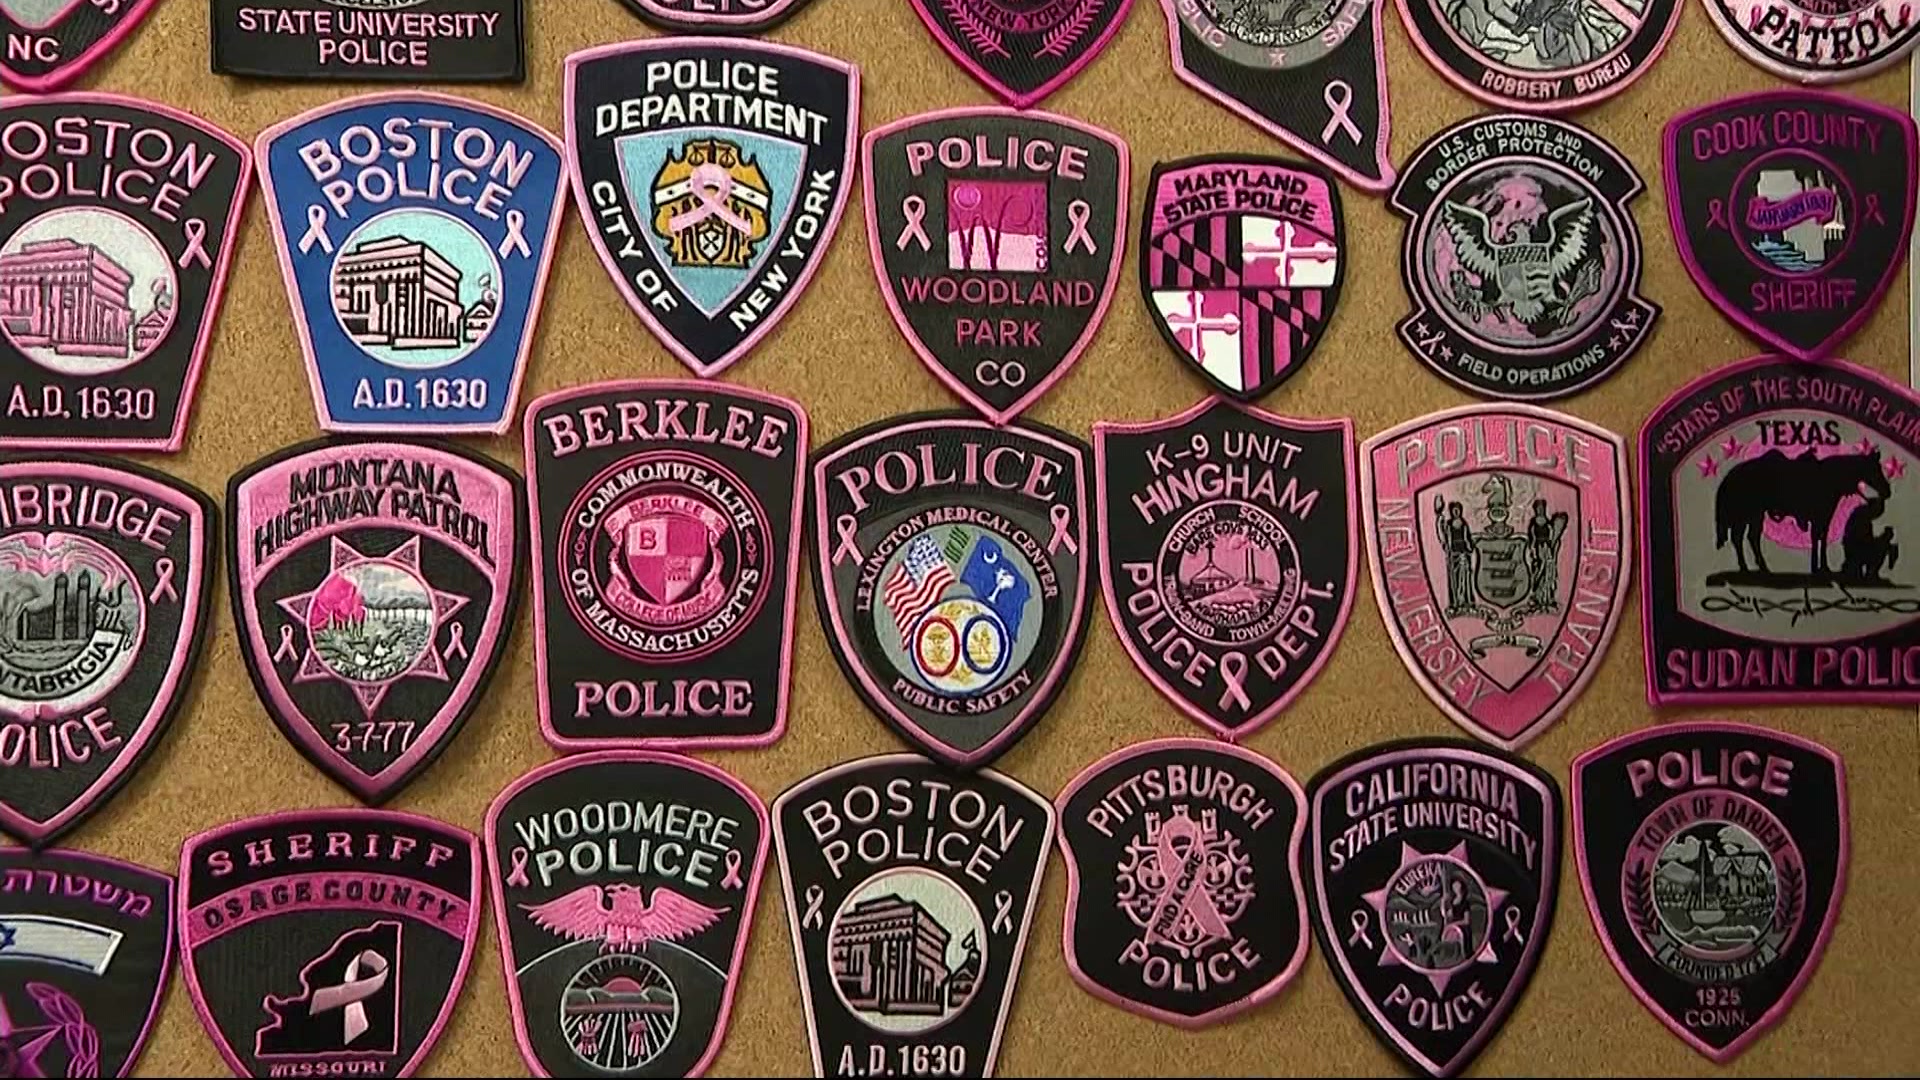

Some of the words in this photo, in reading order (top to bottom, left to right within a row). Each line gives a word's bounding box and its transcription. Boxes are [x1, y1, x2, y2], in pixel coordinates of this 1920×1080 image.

[7, 33, 60, 62] NC
[238, 8, 332, 34] STATE
[338, 9, 500, 37] UNIVERSITY
[1753, 5, 1906, 60] PATROL
[318, 39, 428, 65] POLICE
[646, 59, 779, 95] POLICE
[1480, 70, 1562, 99] ROBBERY
[1573, 52, 1632, 93] BUREAU
[595, 92, 829, 146] DEPARTMENT
[1438, 136, 1470, 159] U.S.
[1473, 122, 1547, 142] CUSTOMS
[1555, 132, 1583, 150] AND
[1692, 115, 1769, 161] COOK
[1772, 110, 1882, 153] COUNTY
[1, 117, 217, 189] OSTON
[299, 117, 534, 188] BOSTON
[906, 136, 1090, 180] POLICE
[1425, 145, 1488, 192] BORDER
[1498, 138, 1604, 183] PROTECTION
[322, 162, 513, 220] POLICE
[1163, 190, 1229, 224] STATE
[1235, 189, 1318, 222] POLICE
[1174, 169, 1308, 196] MARYLAND
[591, 180, 643, 262] CITY
[634, 270, 679, 313] OF
[729, 268, 790, 332] NEW
[781, 168, 836, 260] YORK
[902, 276, 1095, 308] WOODLAND
[1750, 278, 1857, 313] SHERIFF
[956, 318, 1042, 347] PARK
[975, 361, 1026, 387] CO
[1457, 353, 1503, 382] FIELD
[1507, 344, 1606, 384] OPERATIONS
[1723, 384, 1746, 414] OF
[1751, 375, 1792, 400] THE
[1796, 378, 1864, 412] SOUTH
[543, 399, 789, 459] BERKLEE
[1146, 434, 1211, 475] K-9
[1223, 430, 1303, 470] UNIT
[1397, 418, 1592, 491] POLICE
[1756, 419, 1842, 446] TEXAS
[289, 458, 461, 503] MONTANA
[578, 461, 758, 530] COMMONWEALTH
[836, 443, 1063, 514] POLICE
[1131, 463, 1321, 525] HINGHAM
[0, 484, 182, 552] BRIDGE
[254, 489, 385, 566] HIGHWAY
[391, 487, 497, 570] PATROL
[640, 528, 658, 550] B
[1168, 508, 1217, 553] CHURCH
[1238, 505, 1287, 550] SCHOOL
[1379, 497, 1421, 583] NEW
[856, 510, 925, 612] LEXINGTON
[926, 507, 1012, 537] MEDICAL
[1014, 529, 1059, 600] CENTER
[571, 568, 594, 602] OF
[586, 569, 760, 653] MASSACHUSETTS
[1122, 562, 1217, 687] POLICE
[1543, 516, 1619, 694] TRANSIT
[1254, 581, 1336, 681] DEPT.
[1394, 593, 1495, 711] JERSEY
[0, 642, 114, 693] TABRIGIA
[893, 677, 961, 713] PUBLIC
[966, 668, 1034, 713] SAFETY
[1666, 648, 1799, 689] SUDAN
[1813, 645, 1920, 687] POLIC
[574, 680, 753, 718] POLICE
[0, 706, 122, 769] OLICE
[1345, 763, 1520, 820] CALIFORNIA
[1626, 748, 1795, 797] POLICE
[515, 801, 740, 852] WOODMERE
[802, 778, 1025, 854] BOSTON
[1086, 764, 1275, 838] PITTSBURGH
[1637, 804, 1689, 852] TOWN
[1692, 797, 1716, 818] OF
[1722, 799, 1790, 851] DARIEN
[206, 832, 454, 876] SHERIFF
[536, 838, 718, 887] POLICE
[822, 825, 1001, 884] POLICE
[1328, 806, 1399, 873] STATE
[1403, 801, 1538, 871] UNIVERSITY
[3, 869, 152, 918] משטרת
[204, 881, 312, 929] OSAGE
[323, 880, 457, 920] COUNTY
[1117, 936, 1263, 993] POLICE
[1382, 980, 1493, 1032] POLICE
[1684, 1009, 1751, 1028] CONN.
[1695, 988, 1742, 1006] 1925
[270, 1061, 386, 1077] MISSOURI
